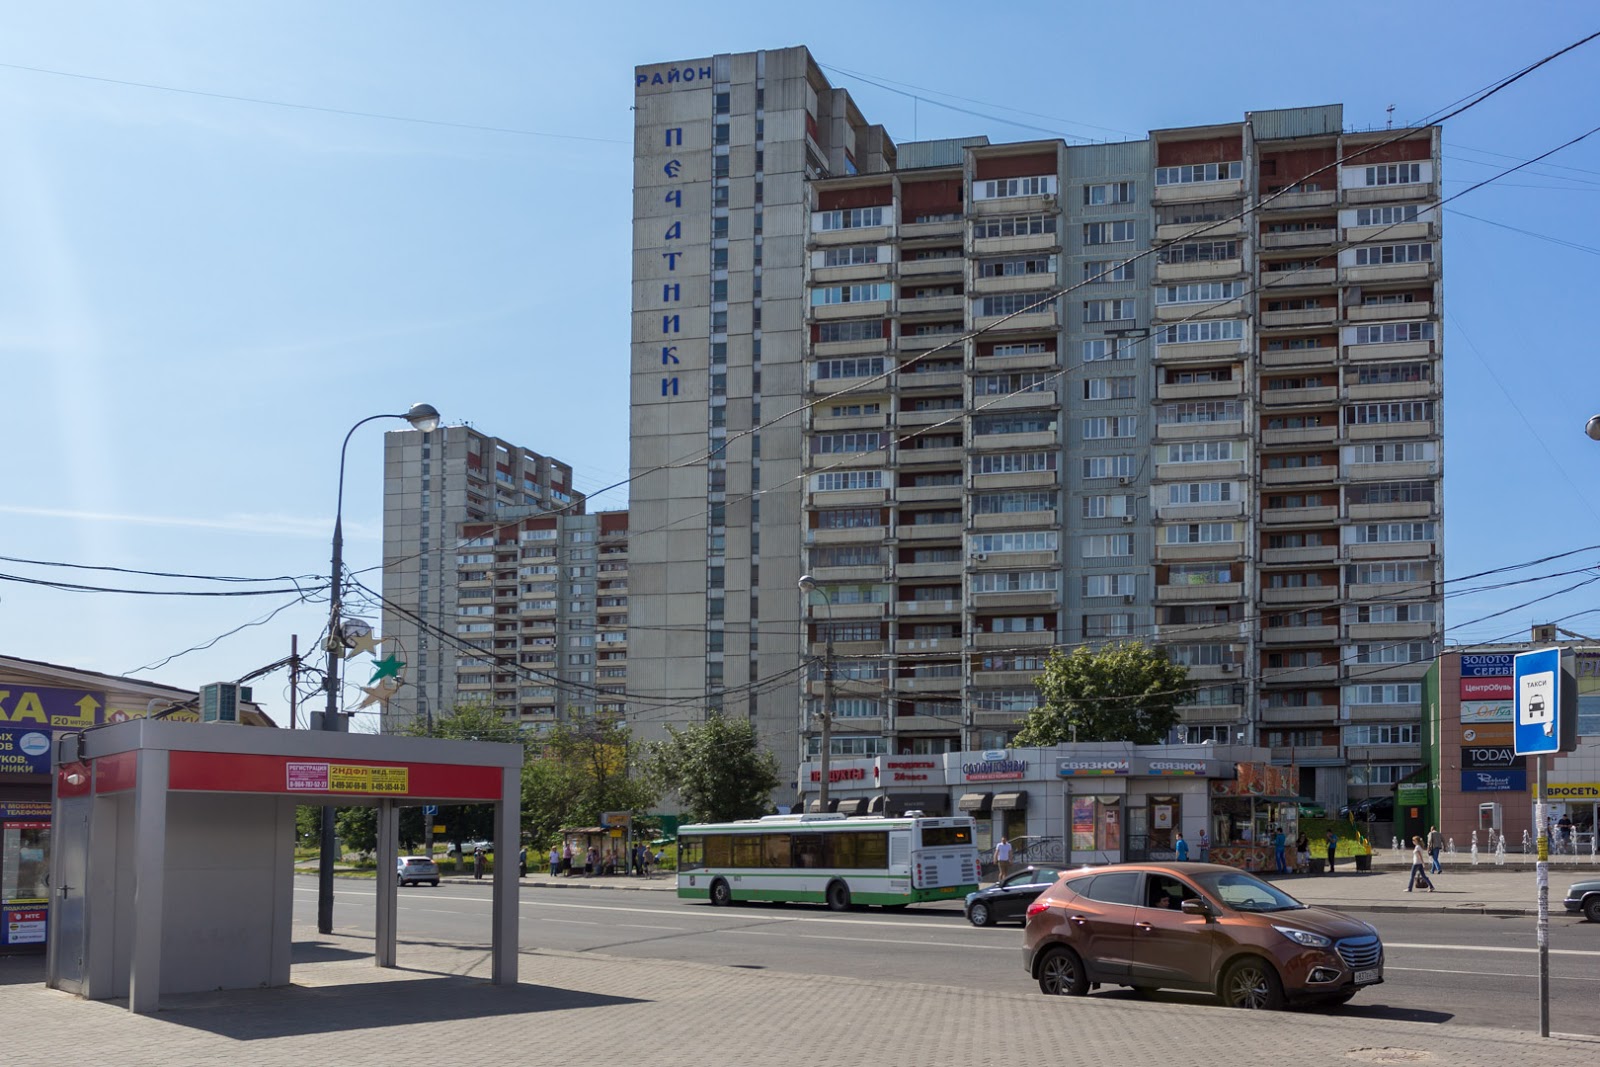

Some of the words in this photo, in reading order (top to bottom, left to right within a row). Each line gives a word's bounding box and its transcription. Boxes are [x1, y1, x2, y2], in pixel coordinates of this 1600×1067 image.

[636, 67, 712, 87] РАЙОН
[661, 127, 683, 397] ПЕЧАТНИКИ
[1463, 655, 1510, 664] ЗОЛОТО
[1465, 684, 1511, 692] ЦентрОбувь
[1527, 680, 1547, 688] ТАКСИ
[53, 716, 69, 725] 20
[0, 755, 28, 764] КОВ,
[332, 767, 368, 776] 2НДФЛ
[810, 768, 865, 783] ПРДУКТЫ
[1547, 788, 1598, 796] ВРОСЕТЬ
